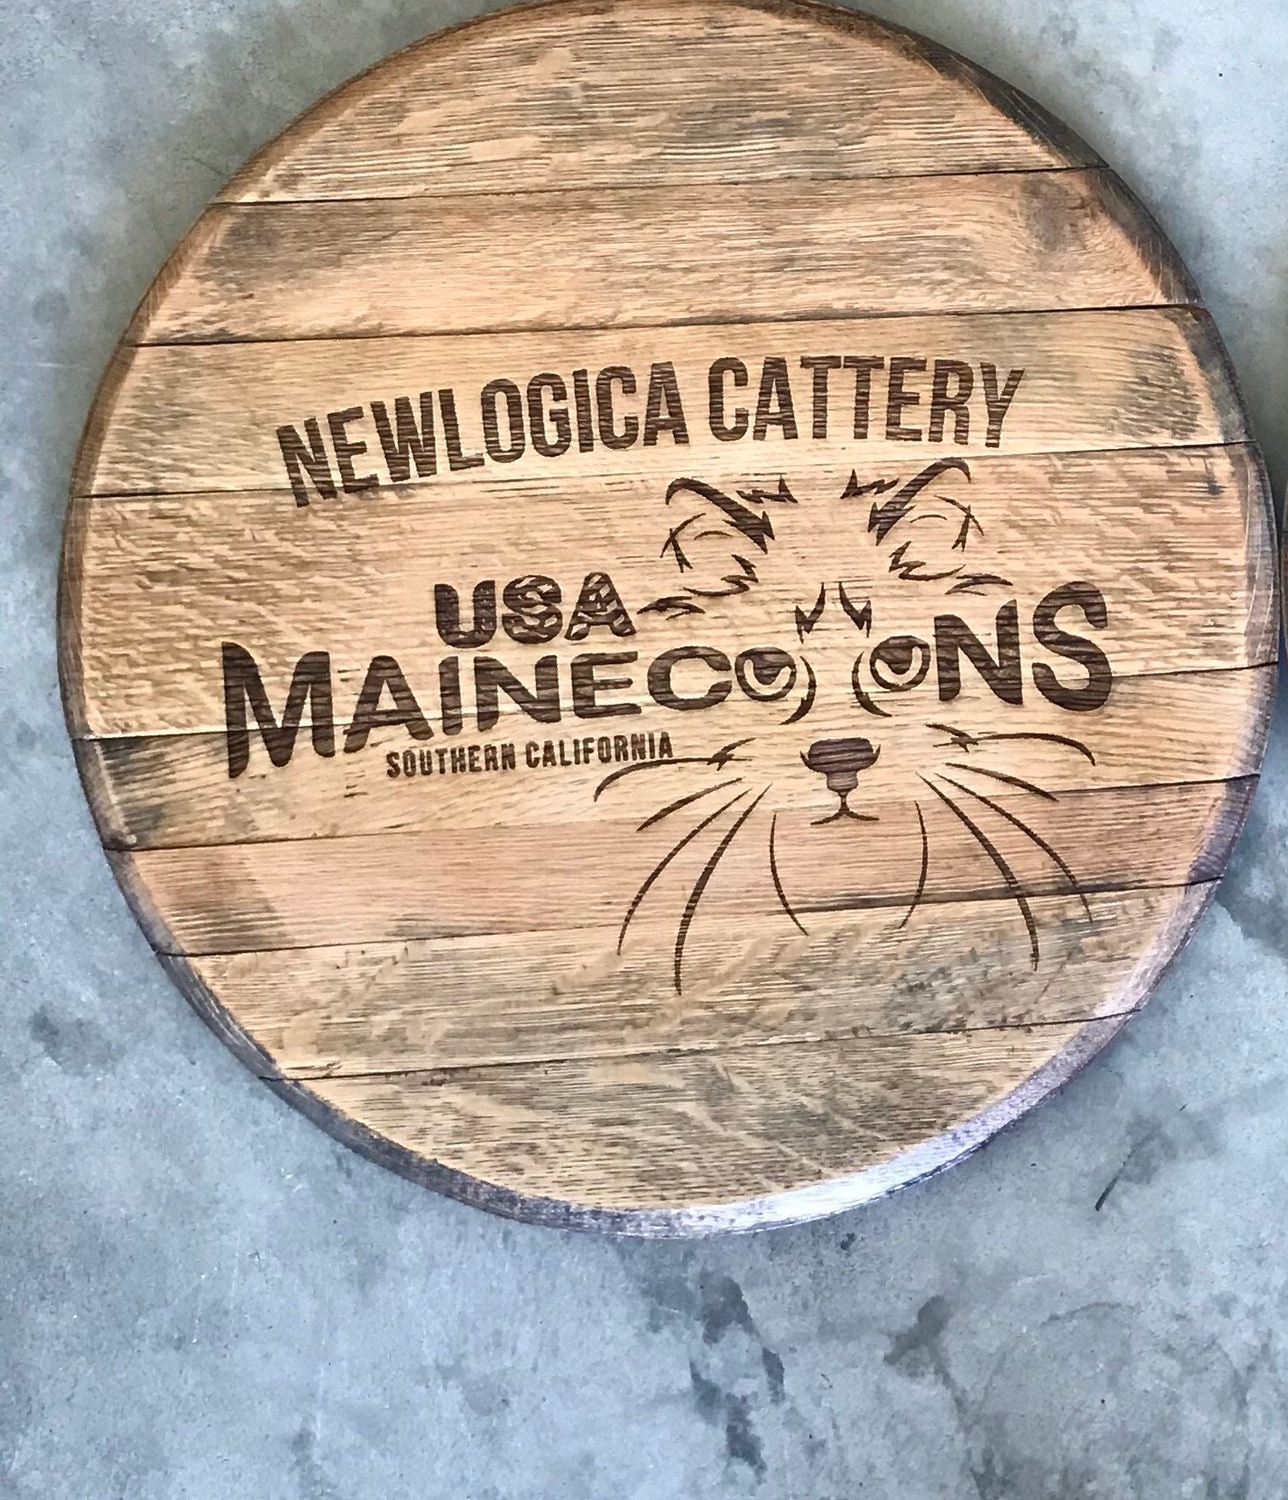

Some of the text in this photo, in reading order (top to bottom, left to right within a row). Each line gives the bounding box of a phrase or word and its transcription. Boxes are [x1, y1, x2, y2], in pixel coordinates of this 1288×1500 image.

[276, 355, 1026, 509] NEWLOGICA CATTERY
[433, 572, 637, 650] USA
[385, 730, 675, 779] SOUTHERN CALIFORNIA
